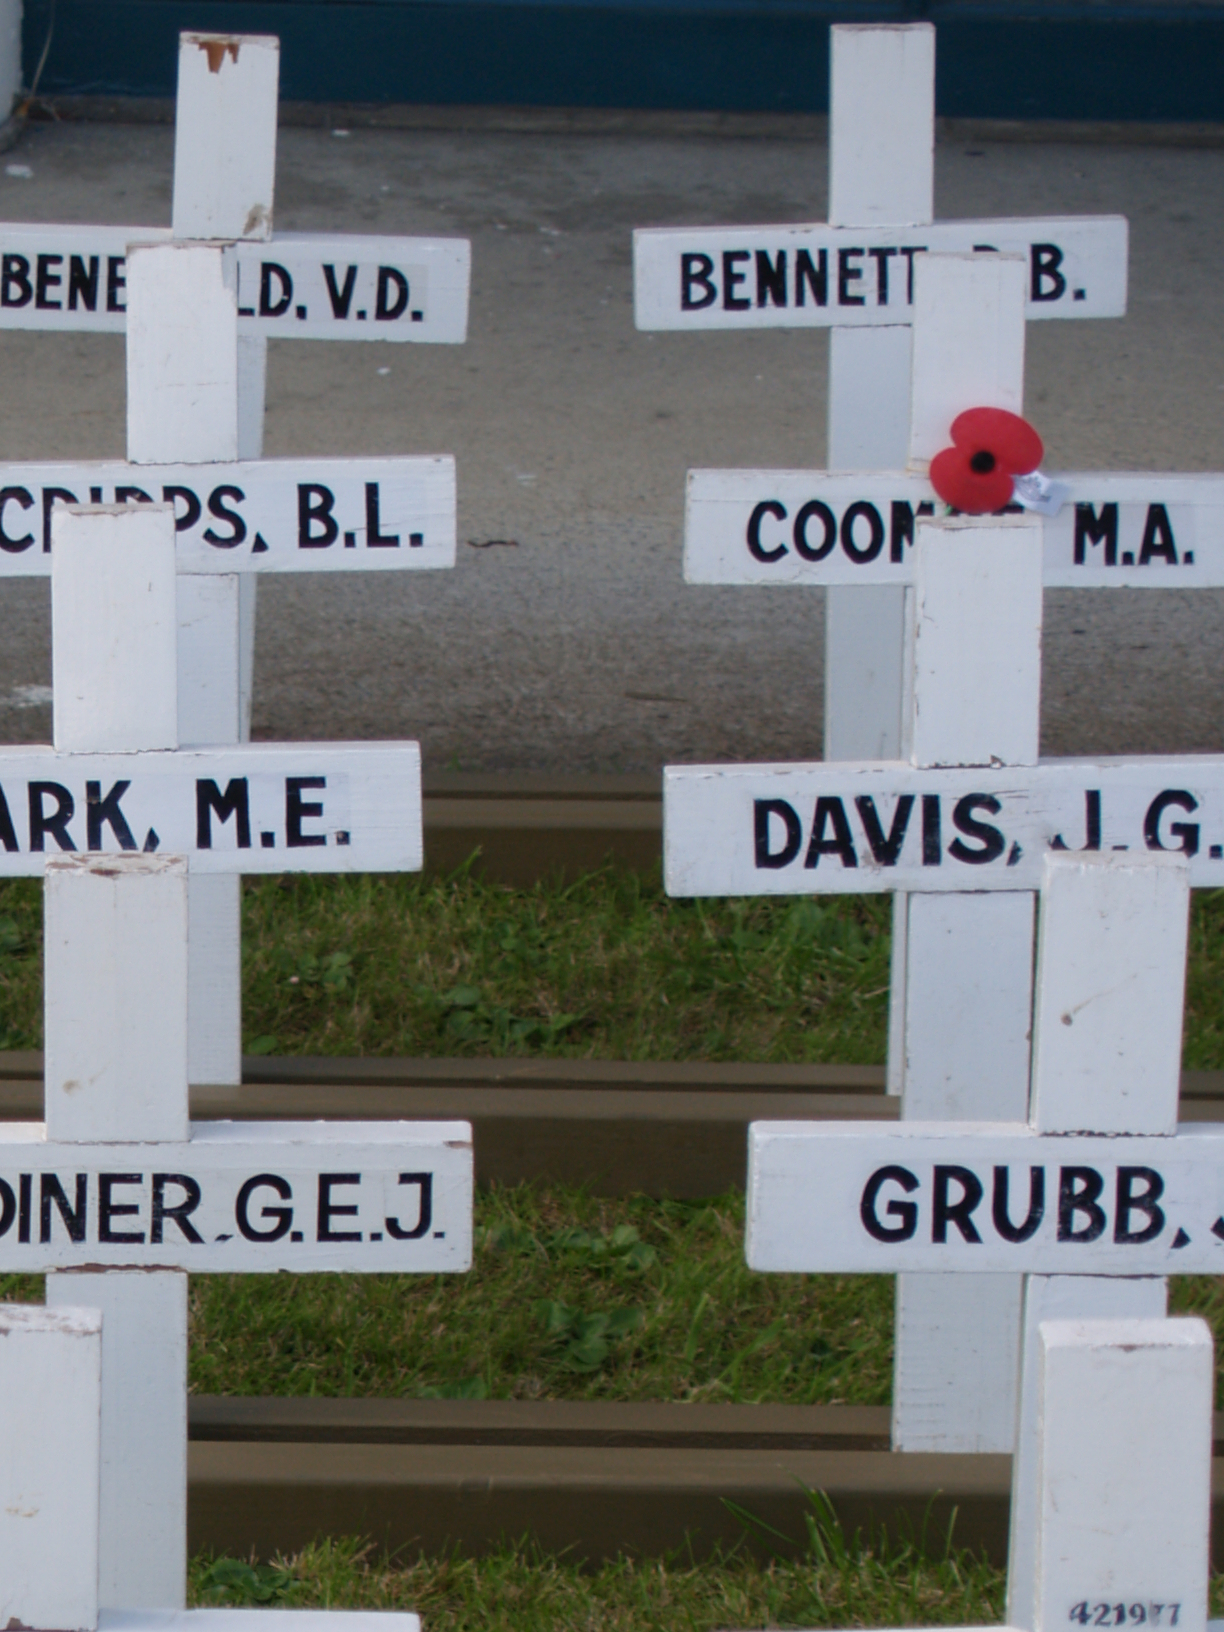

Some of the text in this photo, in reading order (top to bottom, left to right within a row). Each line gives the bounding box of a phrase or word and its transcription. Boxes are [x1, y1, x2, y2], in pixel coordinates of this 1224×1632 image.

[321, 263, 424, 323] V.D.
[296, 481, 424, 549] B.L.
[1072, 501, 1194, 567] M.A.
[195, 775, 351, 850] M.E.
[753, 788, 1223, 870] DAVIS, JG.
[859, 1163, 1191, 1250] GRUBB,
